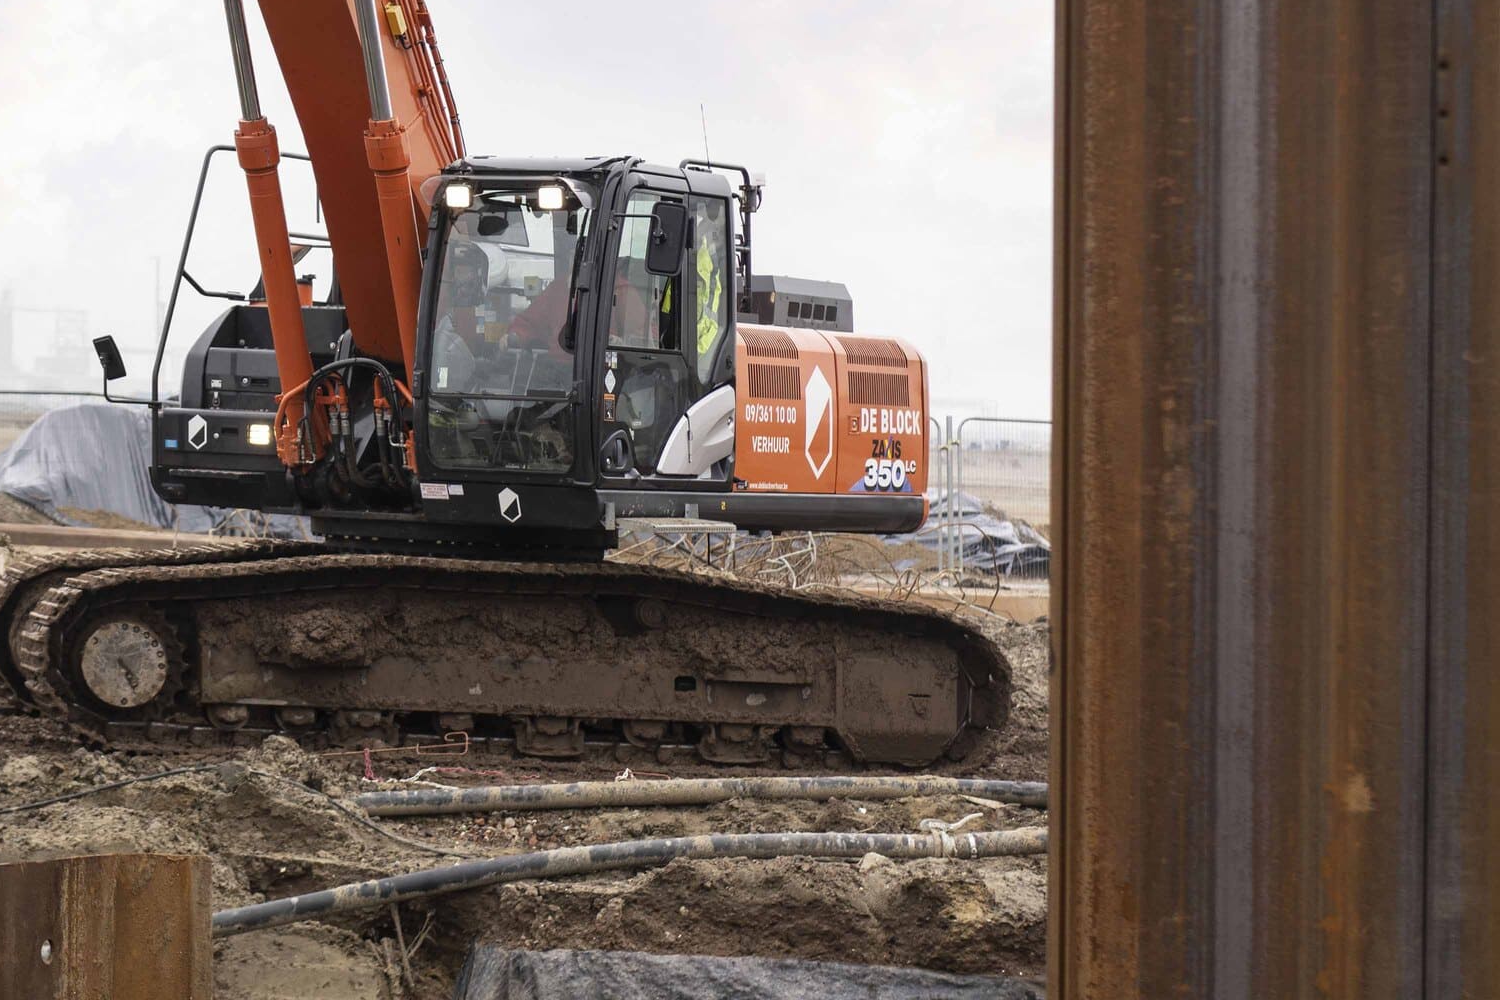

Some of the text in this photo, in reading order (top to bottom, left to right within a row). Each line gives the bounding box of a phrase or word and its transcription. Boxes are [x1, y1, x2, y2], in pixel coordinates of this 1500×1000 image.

[745, 403, 797, 424] 09/361 10 00
[861, 407, 921, 436] DE BLOCK
[752, 435, 790, 454] VERHUUR
[872, 435, 901, 459] ZAXIS
[864, 458, 906, 490] 350
